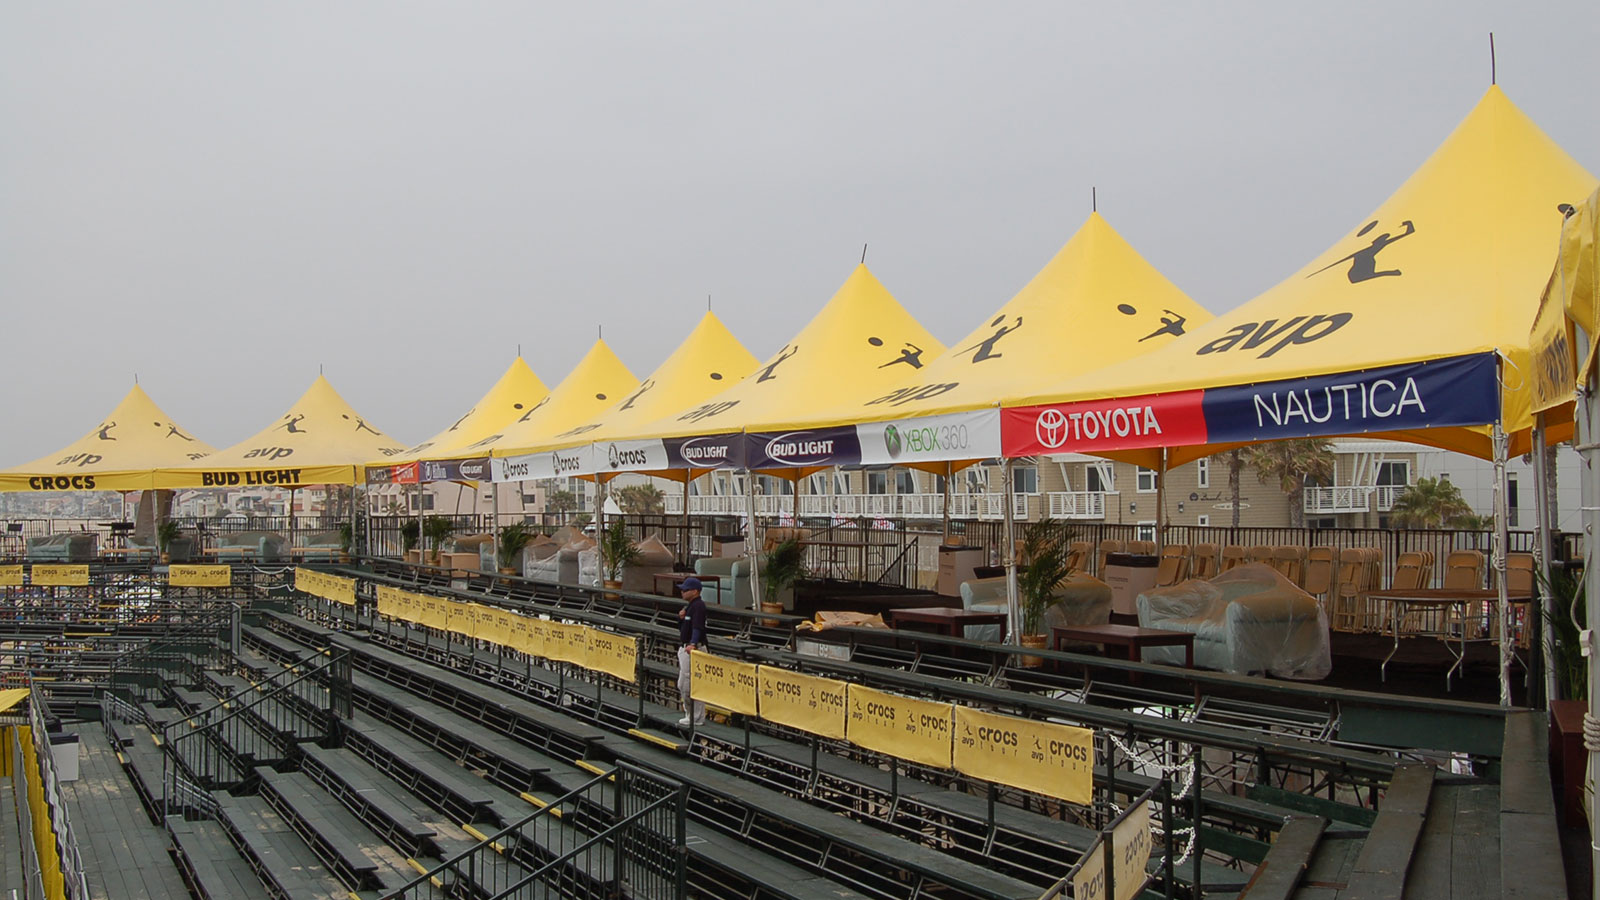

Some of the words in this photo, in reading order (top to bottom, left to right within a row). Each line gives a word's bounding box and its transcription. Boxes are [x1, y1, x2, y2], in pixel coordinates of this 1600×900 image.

[1196, 312, 1354, 360] avp
[1253, 377, 1426, 427] NAUTICA
[1069, 406, 1163, 441] TOYOTA
[243, 446, 294, 461] avp
[619, 449, 647, 465] crocs
[685, 446, 702, 459] BUD
[703, 445, 728, 458] LIGHT
[772, 443, 797, 458] BUD
[798, 440, 834, 456] LIGHT
[56, 453, 103, 467] avp
[560, 456, 580, 471] crocs
[202, 471, 240, 486] BUD
[246, 469, 302, 485] LIGHT
[509, 463, 529, 477] crocs
[29, 475, 96, 490] CROCS
[704, 663, 724, 678] crocs
[776, 680, 802, 697] crocs
[820, 690, 844, 708] crocs
[867, 702, 896, 721] crocs
[961, 736, 975, 748] avp
[978, 726, 1019, 747] crocs
[1031, 751, 1045, 764] avp
[1049, 740, 1088, 762] crocs
